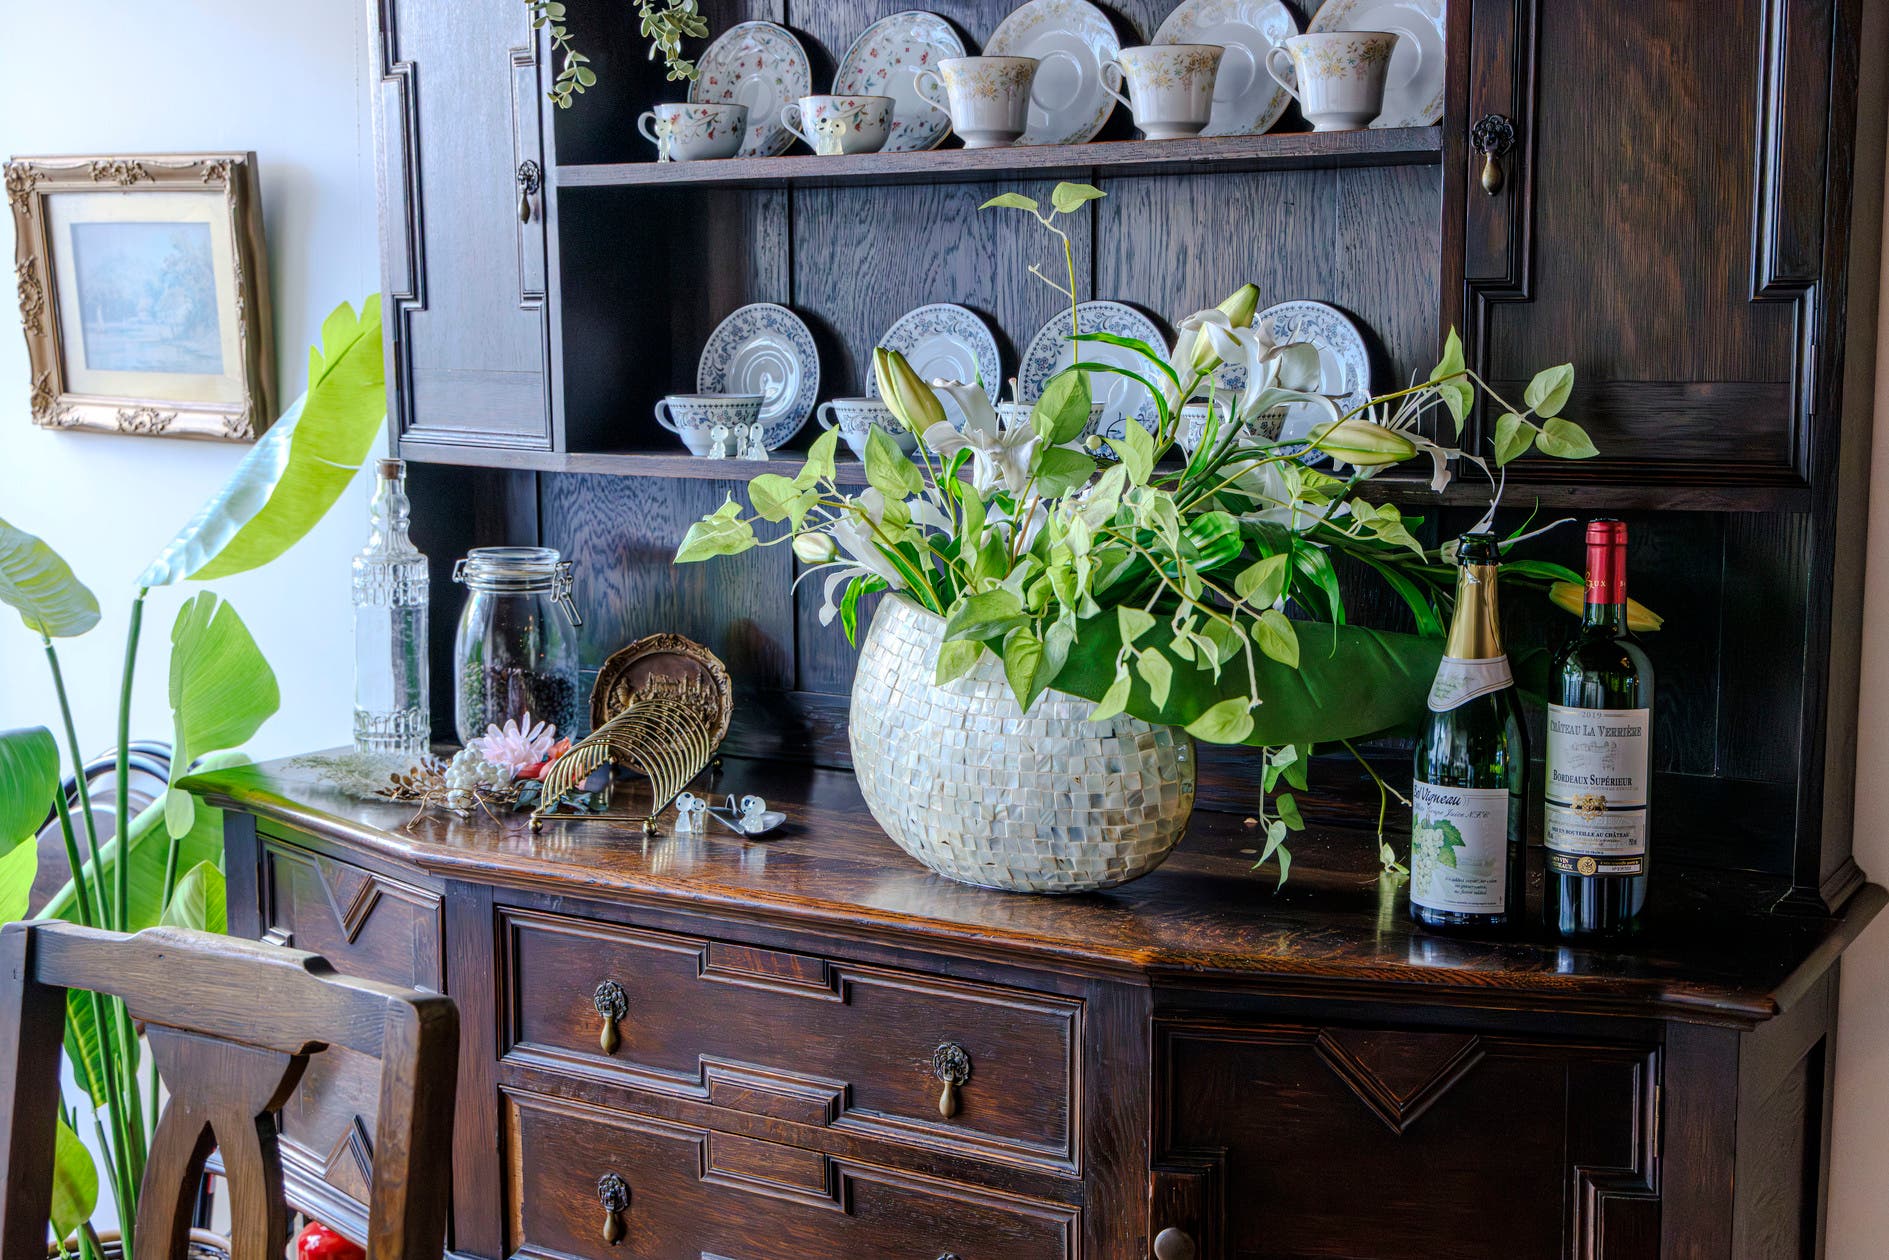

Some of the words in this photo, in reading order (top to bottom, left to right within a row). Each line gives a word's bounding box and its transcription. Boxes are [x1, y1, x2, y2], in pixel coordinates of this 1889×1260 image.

[1582, 711, 1602, 720] 2019
[1583, 725, 1596, 737] LA
[1597, 724, 1642, 737] VERRIÈRE
[1553, 769, 1589, 785] BORDEAUX
[1589, 774, 1633, 787] SUPÉRIEUR
[1422, 786, 1461, 806] Vigneau
